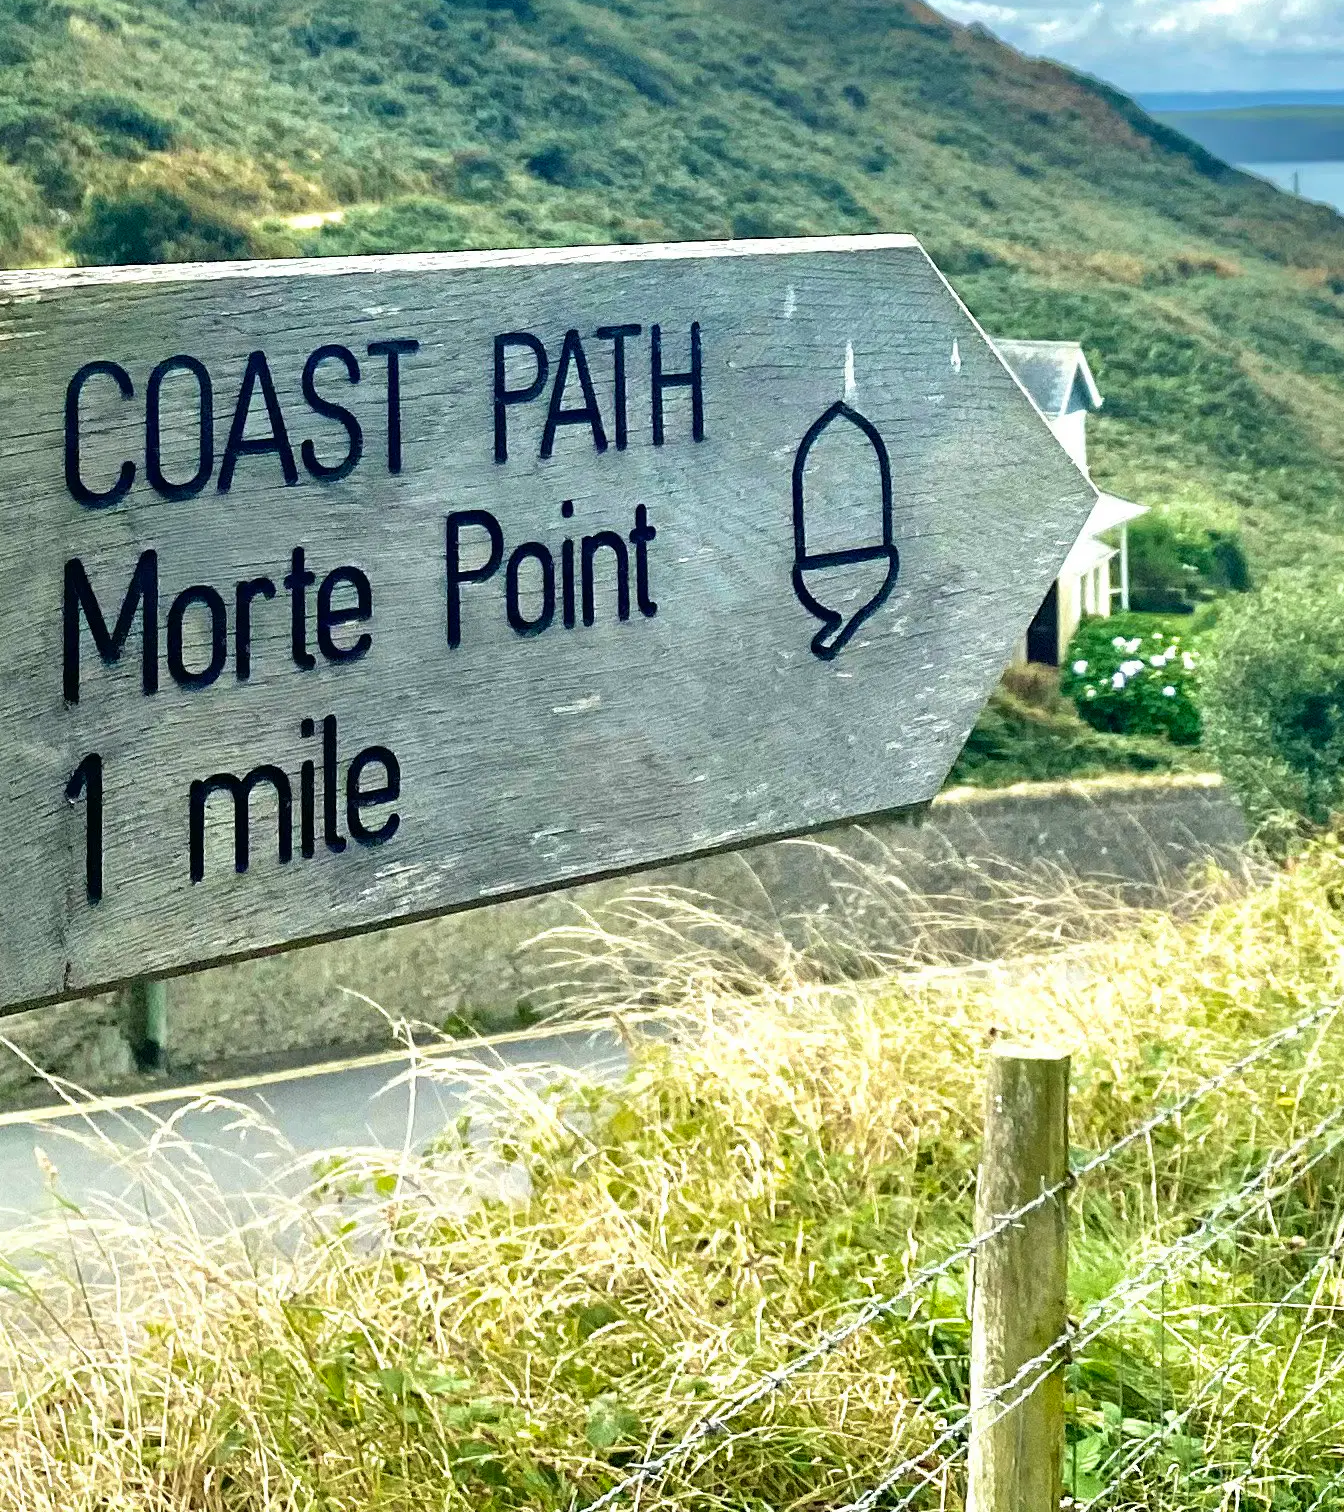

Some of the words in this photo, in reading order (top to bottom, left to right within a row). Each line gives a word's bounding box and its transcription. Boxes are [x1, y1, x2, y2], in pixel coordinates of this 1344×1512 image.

[63, 338, 419, 510] COAST
[493, 321, 706, 465] PATH
[62, 548, 373, 704] Morte
[446, 499, 658, 649] Point
[63, 751, 103, 905] 1
[189, 713, 402, 885] mile
